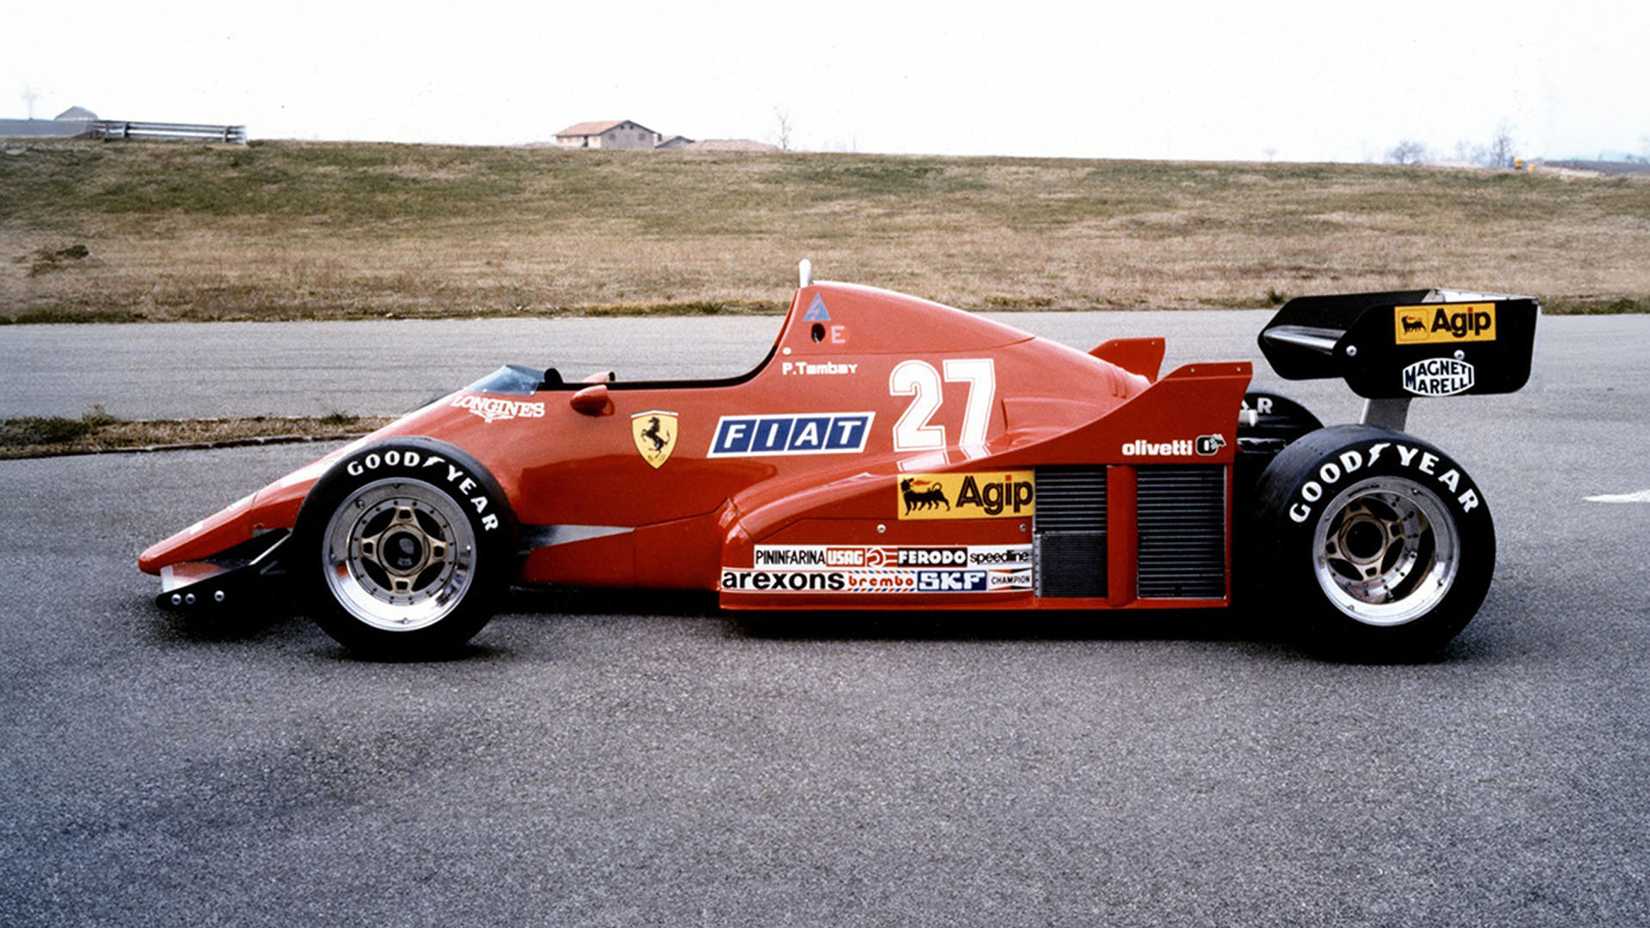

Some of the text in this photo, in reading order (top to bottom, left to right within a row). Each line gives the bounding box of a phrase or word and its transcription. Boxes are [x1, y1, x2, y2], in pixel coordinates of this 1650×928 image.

[1430, 307, 1492, 338] Agip
[830, 325, 846, 344] E
[1404, 360, 1472, 381] MAGNETI
[1404, 374, 1472, 394] MARELLI
[449, 395, 545, 418] LONGINES
[889, 358, 996, 468] 27
[723, 422, 862, 449] FIAT
[1122, 440, 1193, 456] olivetti
[956, 475, 1034, 515] Agip
[755, 549, 1030, 565] PININFARINA USAG FERODO speedline
[722, 571, 1031, 590] arexons brembo SKF CHAMPION
